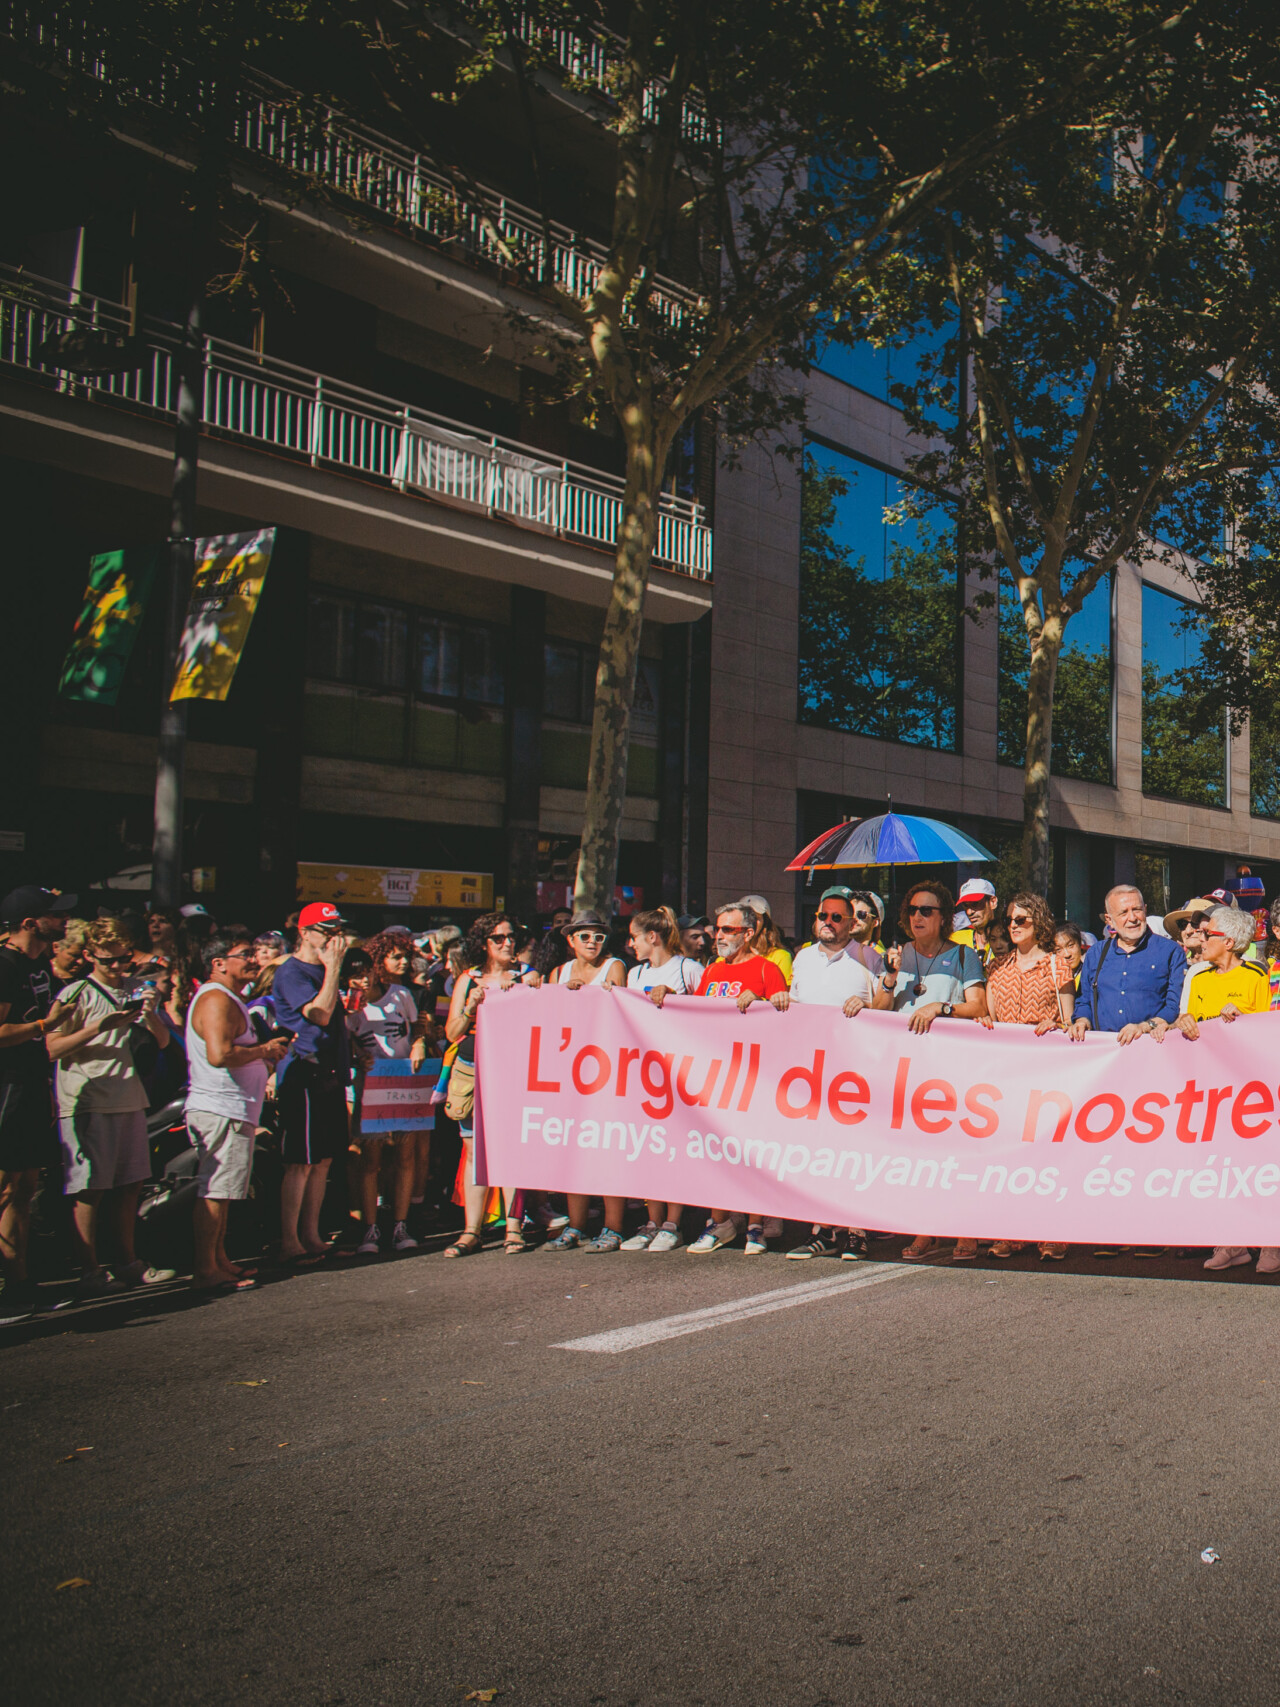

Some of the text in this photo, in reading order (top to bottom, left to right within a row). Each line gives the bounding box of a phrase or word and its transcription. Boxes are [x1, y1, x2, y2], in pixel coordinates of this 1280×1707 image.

[387, 879, 411, 891] HGT
[705, 981, 743, 998] BRS
[386, 1091, 421, 1102] TRANS
[775, 1049, 872, 1126] de
[890, 1057, 1004, 1140] les
[376, 1107, 425, 1125] KIDS
[520, 1106, 574, 1146] Fer
[577, 1118, 676, 1162] anys,
[1084, 1154, 1135, 1197] és
